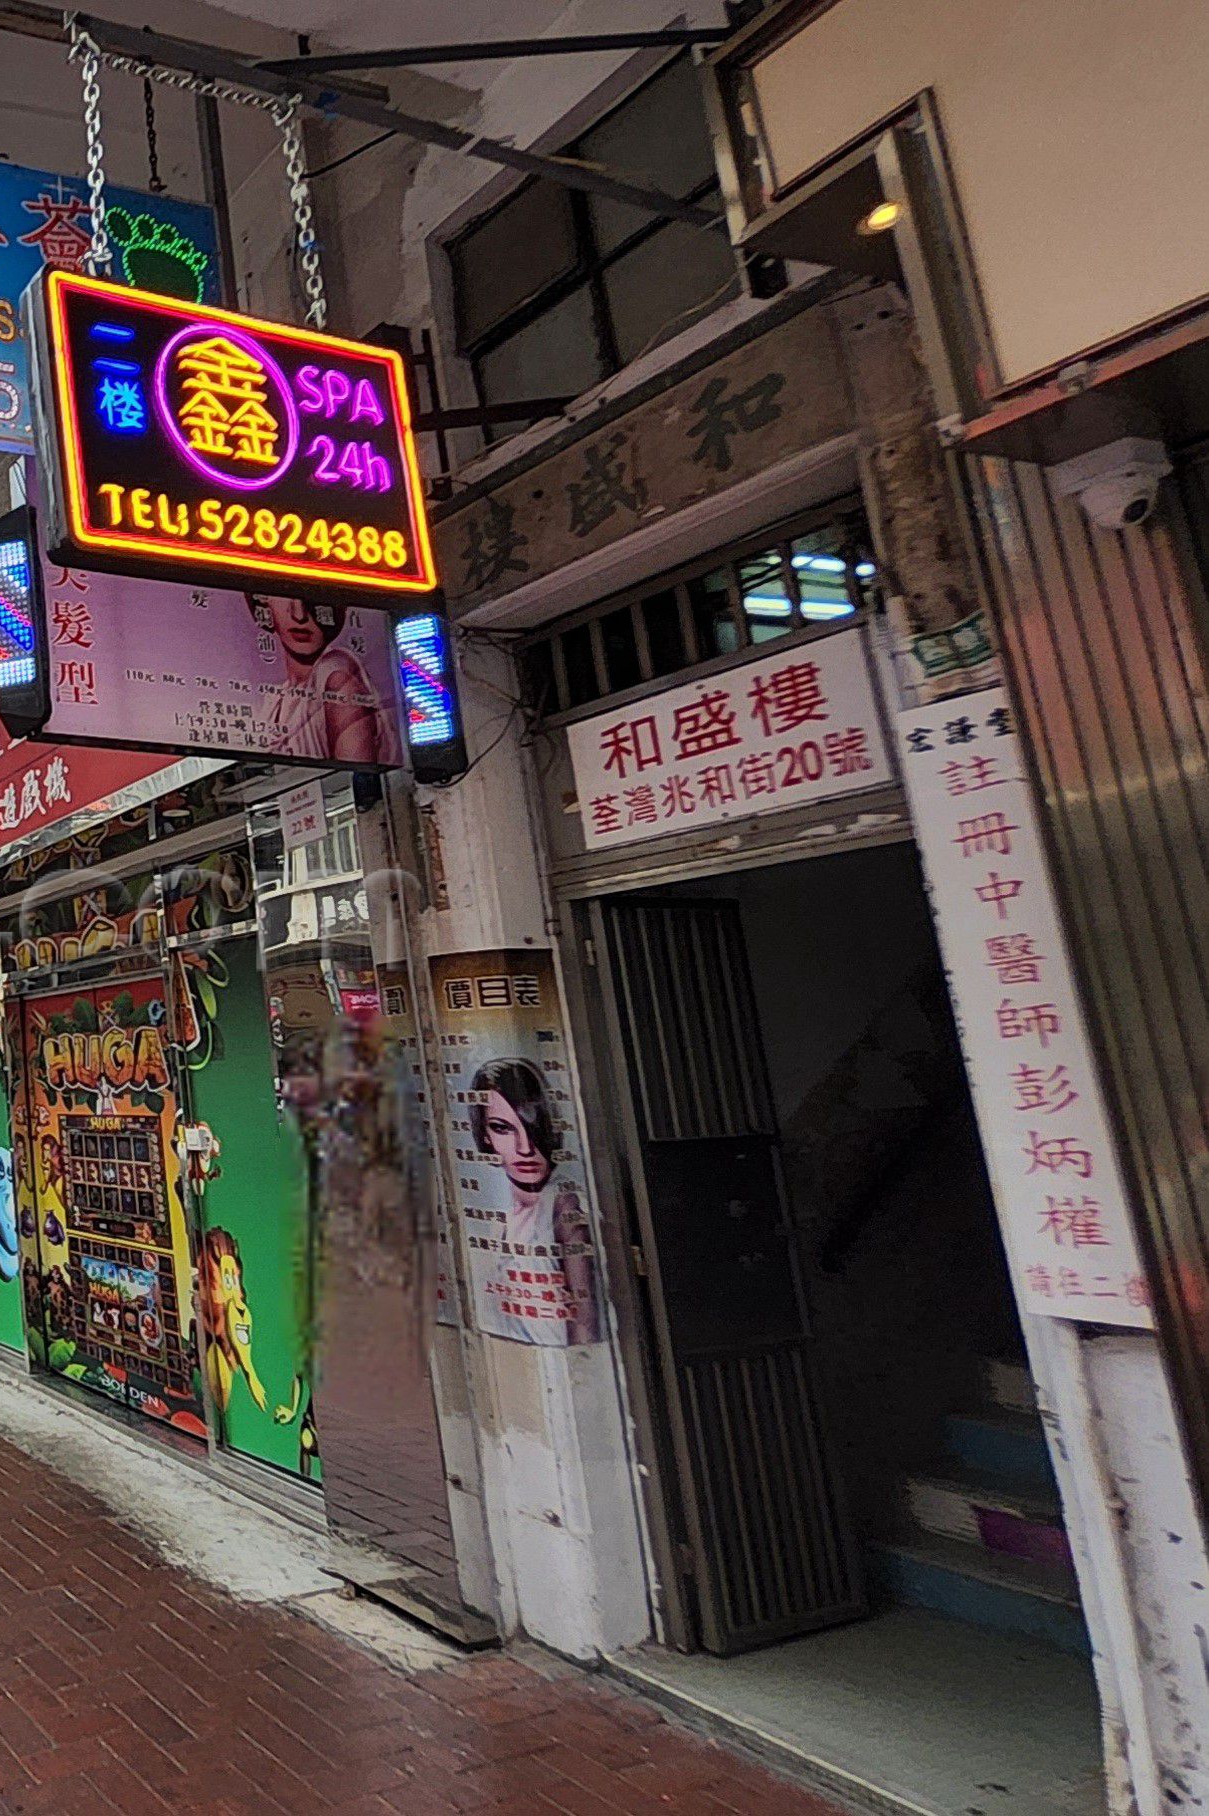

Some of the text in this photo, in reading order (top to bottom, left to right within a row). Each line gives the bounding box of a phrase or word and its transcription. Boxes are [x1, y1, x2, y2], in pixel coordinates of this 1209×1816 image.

[177, 336, 282, 466] 鑫
[294, 363, 386, 427] SPA
[305, 433, 393, 493] 24h
[197, 498, 409, 568] 52824388
[599, 660, 830, 780] 和盛樓
[589, 726, 874, 836] 荃灣兆和街20號
[444, 974, 541, 1011] 價目表
[42, 1025, 172, 1094] HUGA
